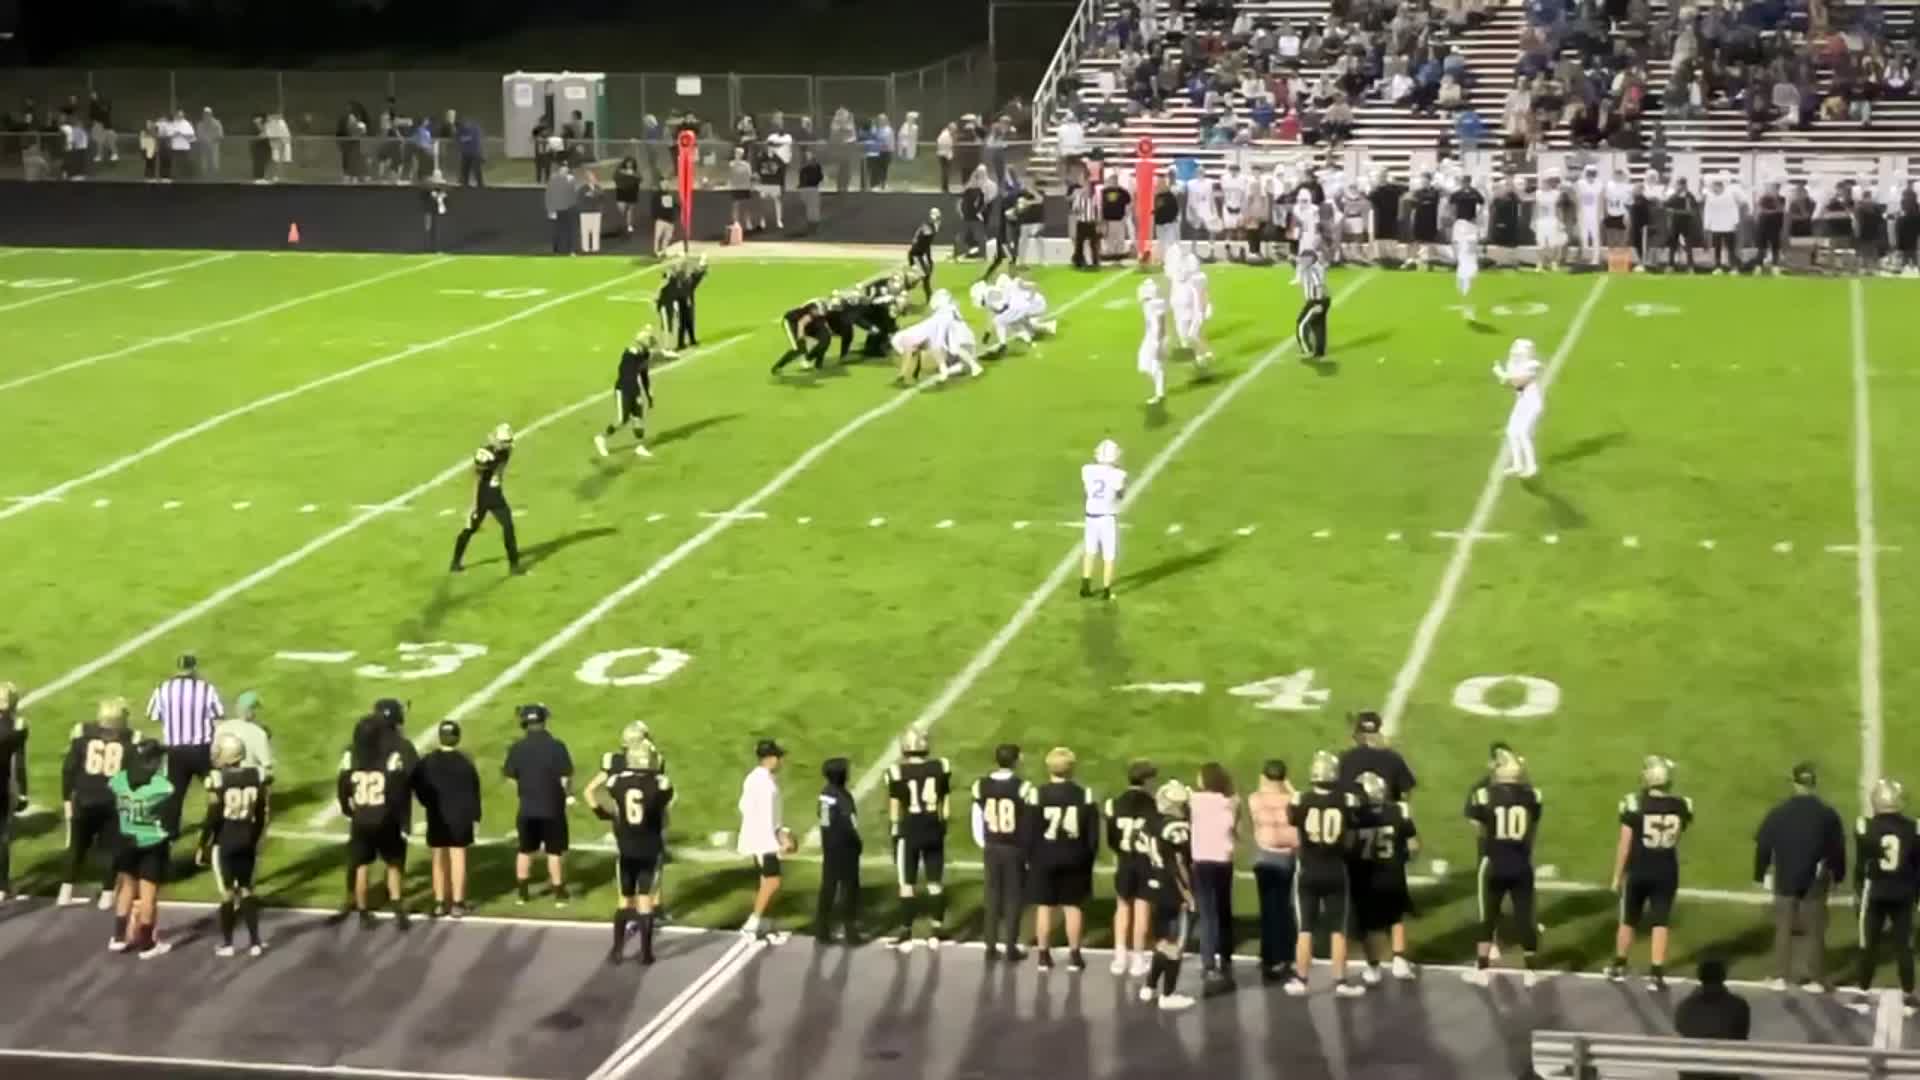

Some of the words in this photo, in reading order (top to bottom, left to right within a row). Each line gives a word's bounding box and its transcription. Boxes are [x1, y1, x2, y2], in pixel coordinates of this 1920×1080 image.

[1091, 479, 1106, 499] 2
[85, 739, 123, 777] 68
[351, 770, 386, 806] 32
[906, 777, 938, 814] 14
[625, 788, 644, 825] 6
[984, 798, 1016, 833] 48
[1043, 805, 1081, 840] 74
[1493, 804, 1527, 840] 10
[1304, 807, 1342, 844] 40
[1358, 825, 1395, 860] 75
[1642, 813, 1681, 849] 52
[1879, 833, 1900, 871] 3
